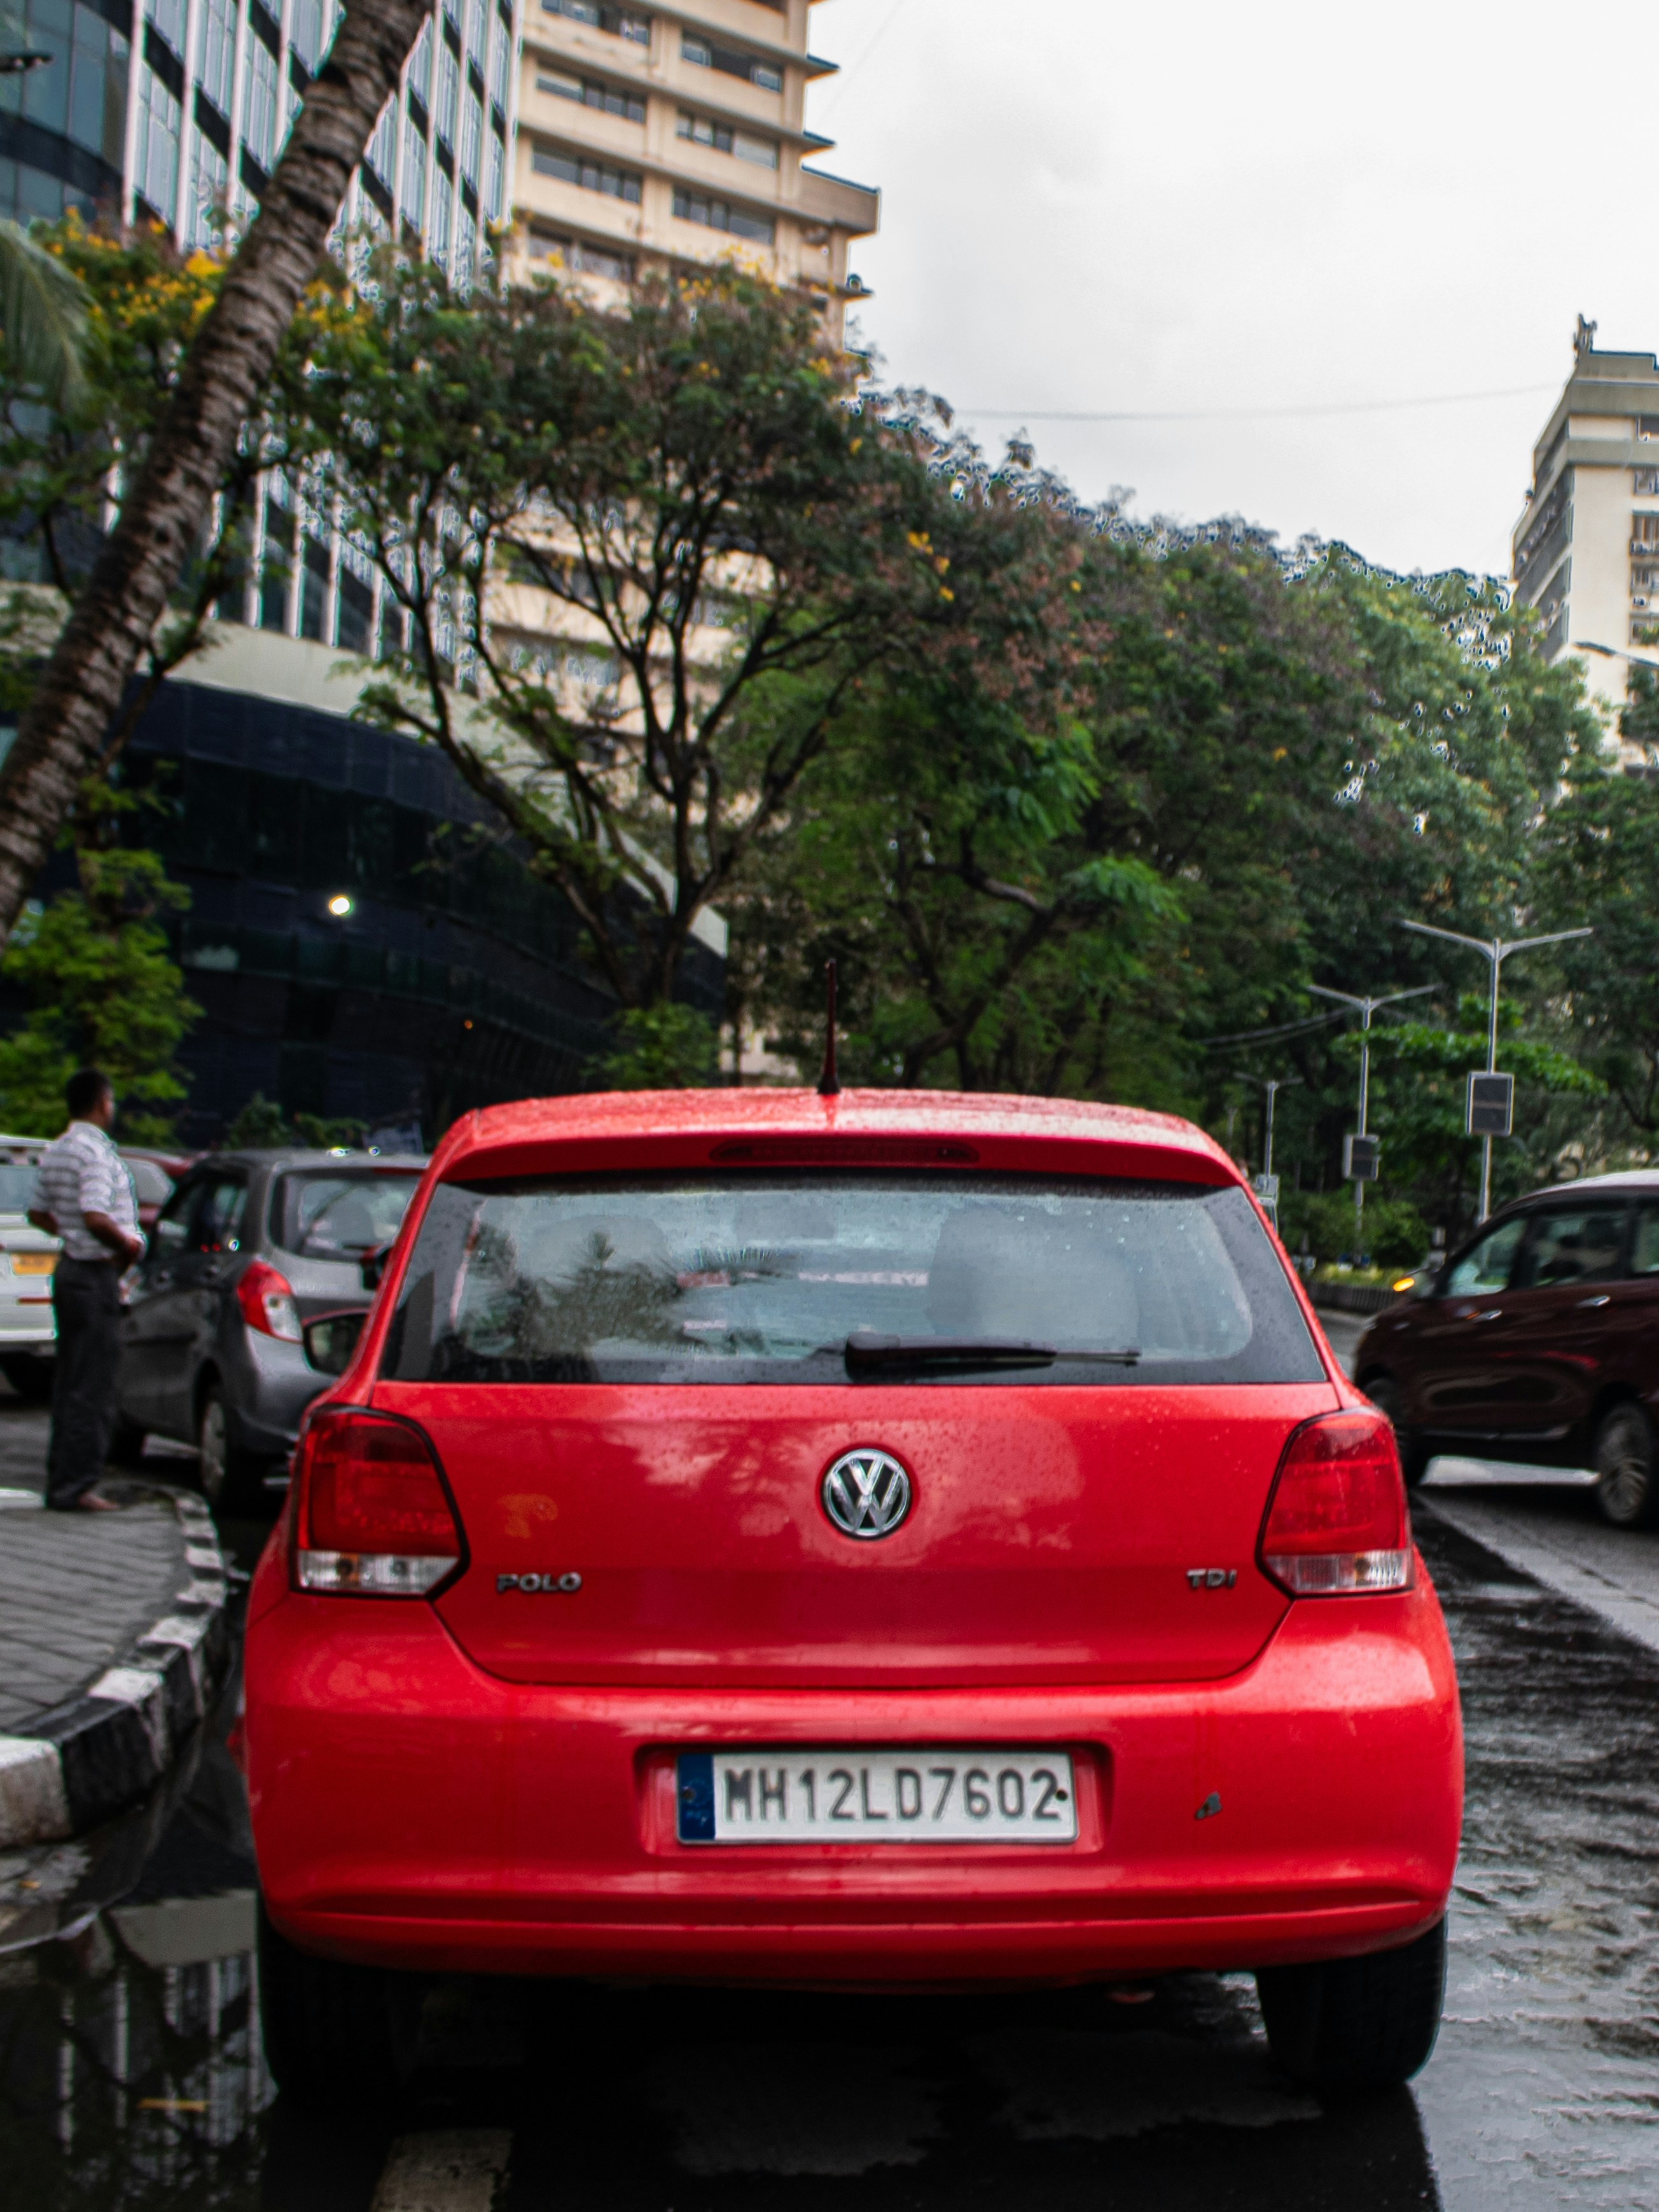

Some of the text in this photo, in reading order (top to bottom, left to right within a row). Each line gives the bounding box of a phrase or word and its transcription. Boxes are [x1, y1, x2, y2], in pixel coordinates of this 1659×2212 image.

[497, 1572, 582, 1593] POLO
[1186, 1567, 1238, 1588] TDI
[724, 1767, 1061, 1821] MH12LD7602
